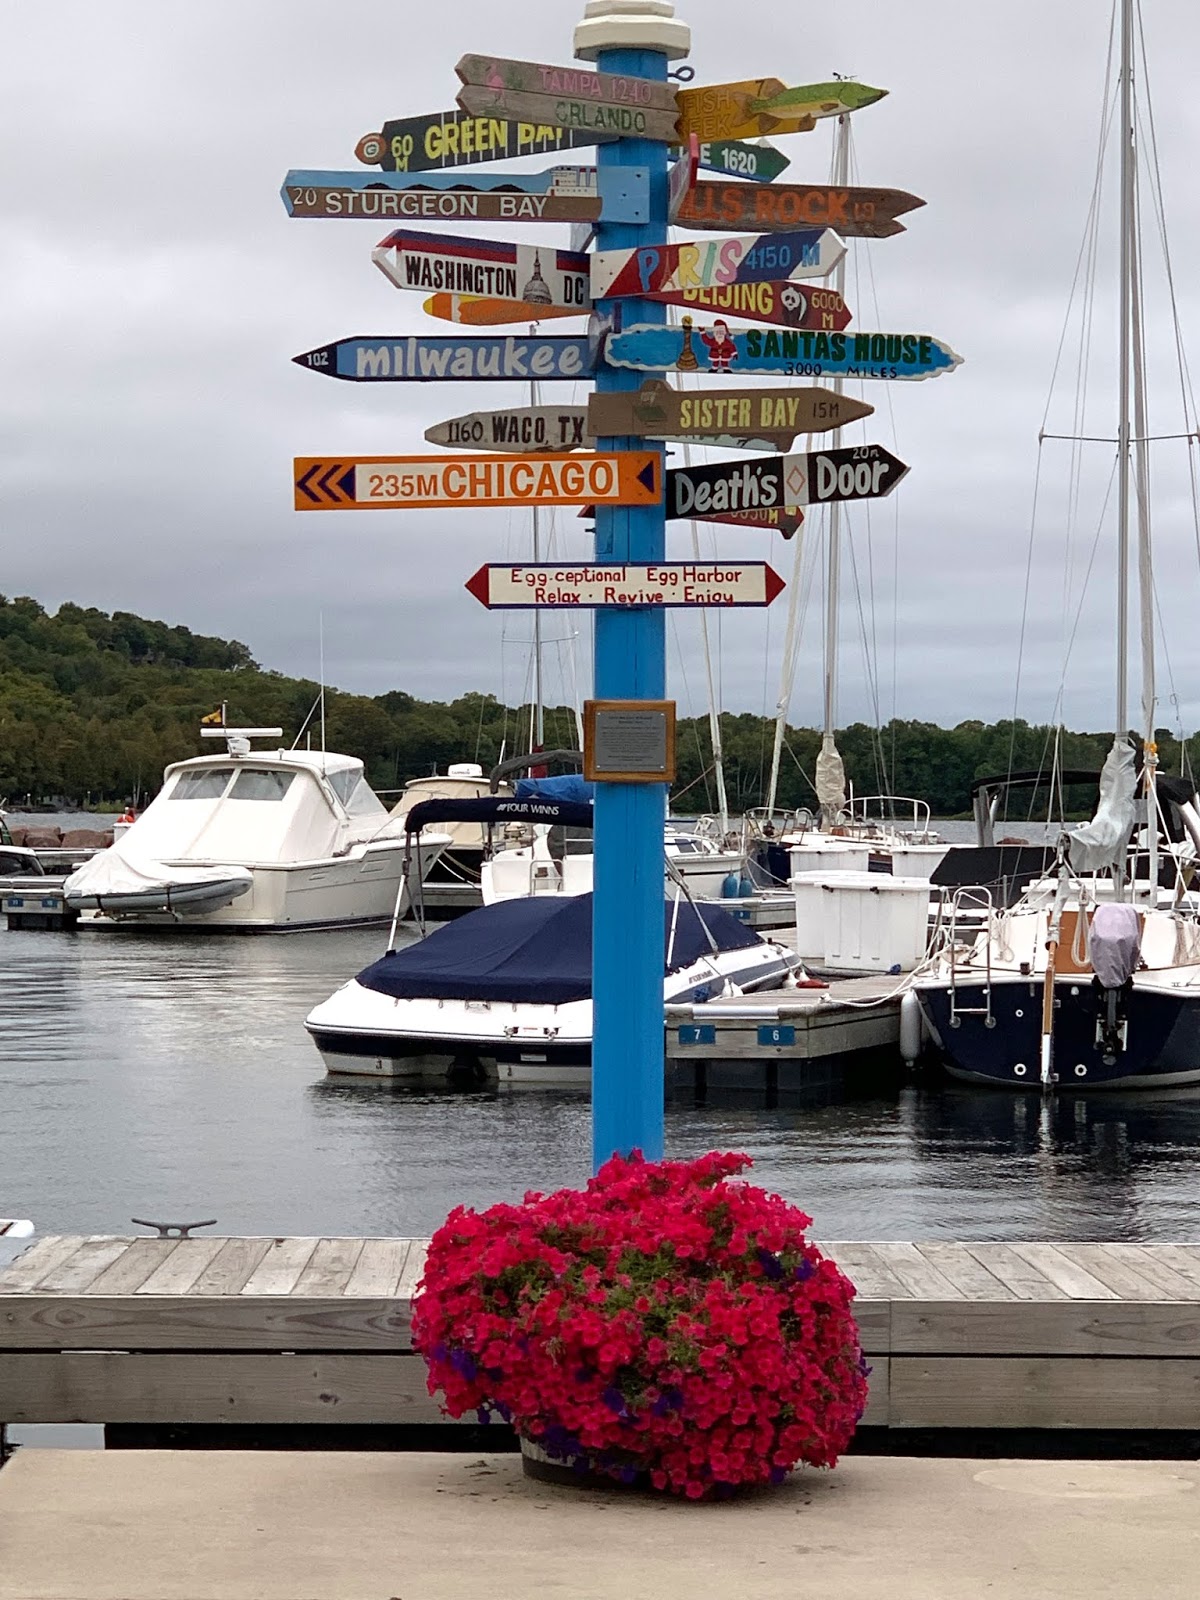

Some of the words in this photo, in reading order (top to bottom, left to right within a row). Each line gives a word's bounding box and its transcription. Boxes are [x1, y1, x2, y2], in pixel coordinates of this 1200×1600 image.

[538, 67, 603, 97] TAMPA
[612, 77, 652, 104] 1240
[555, 101, 647, 133] ORLANDO
[682, 88, 731, 117] FISH
[391, 134, 414, 158] 60
[424, 117, 507, 159] GREEN
[395, 156, 409, 173] M
[721, 147, 757, 175] 1620
[293, 187, 317, 206] 20
[325, 192, 479, 217] STURGEON
[499, 196, 550, 218] BAY
[756, 189, 850, 227] ROCK
[404, 255, 517, 298] WASHINGTON
[563, 275, 585, 306] DC
[637, 240, 742, 292] PARIS
[745, 244, 790, 270] 4150
[801, 243, 820, 267] M
[810, 291, 844, 313] 6000
[821, 312, 834, 329] M
[306, 352, 329, 367] 102
[746, 329, 846, 362] SANTA'S
[854, 333, 932, 365] HOUSE
[784, 361, 822, 377] 3000
[847, 366, 898, 379] MILES
[680, 398, 751, 429] SISTER
[760, 397, 800, 428] BAY
[447, 421, 484, 443] 1160
[492, 416, 549, 446] WACO,
[558, 416, 585, 443] TX
[369, 473, 438, 498] 235M
[442, 460, 614, 499] CHICAGO
[674, 464, 779, 516] Death's
[816, 454, 890, 500] Door
[646, 567, 679, 586] Egg
[682, 566, 742, 583] Harbor
[535, 587, 582, 604] Relax
[604, 587, 664, 603] Revive
[684, 586, 734, 606] Enjoy
[530, 804, 560, 816] WINNS
[694, 1029, 701, 1040] 7
[772, 1029, 780, 1041] 6
